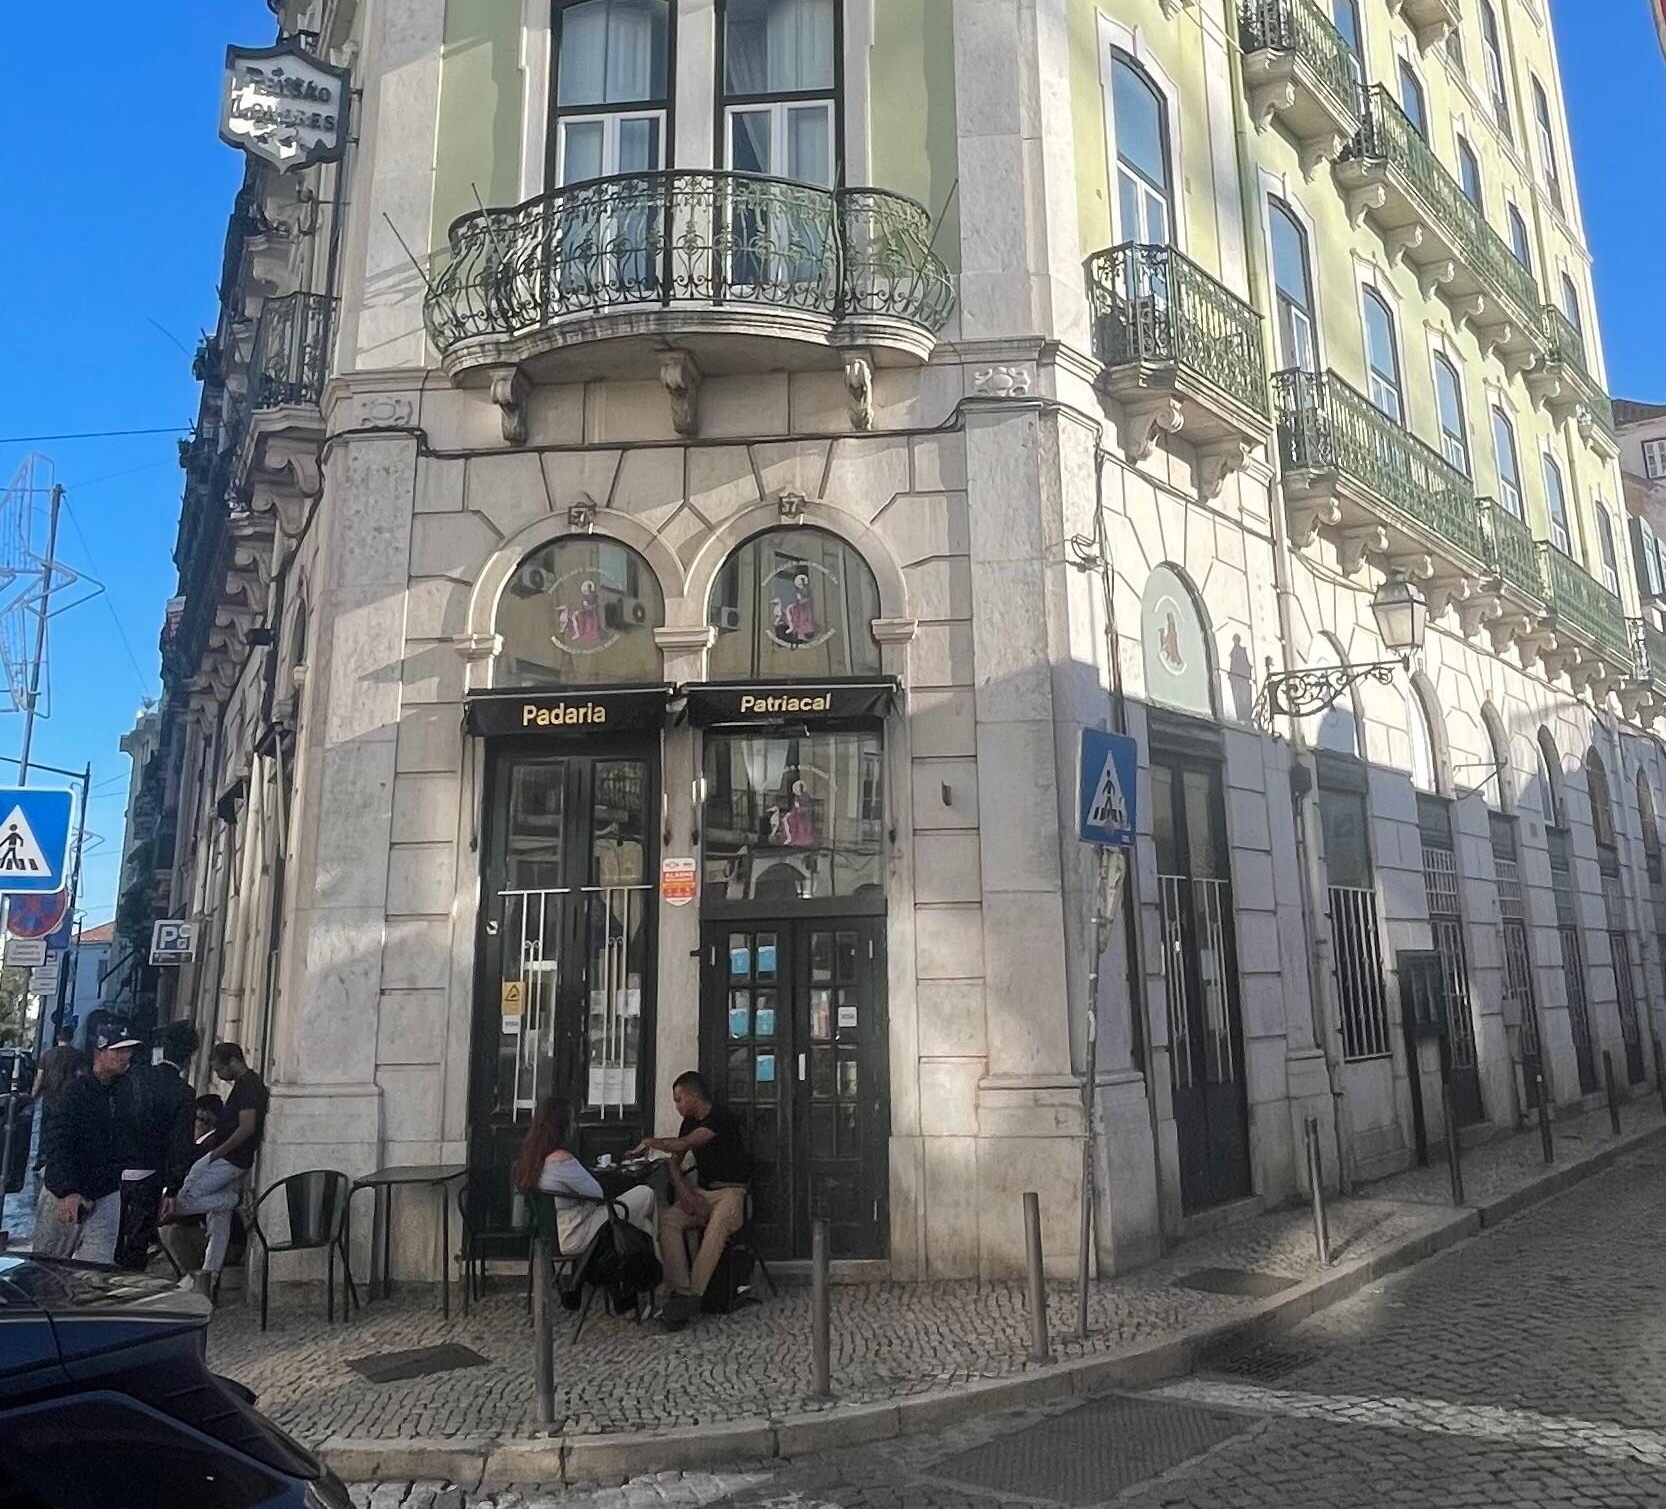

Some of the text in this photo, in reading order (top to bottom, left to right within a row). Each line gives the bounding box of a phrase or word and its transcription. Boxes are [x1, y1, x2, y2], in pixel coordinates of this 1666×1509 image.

[522, 701, 606, 726] Padaria
[740, 692, 832, 713] Patriacal
[159, 926, 178, 949] P
